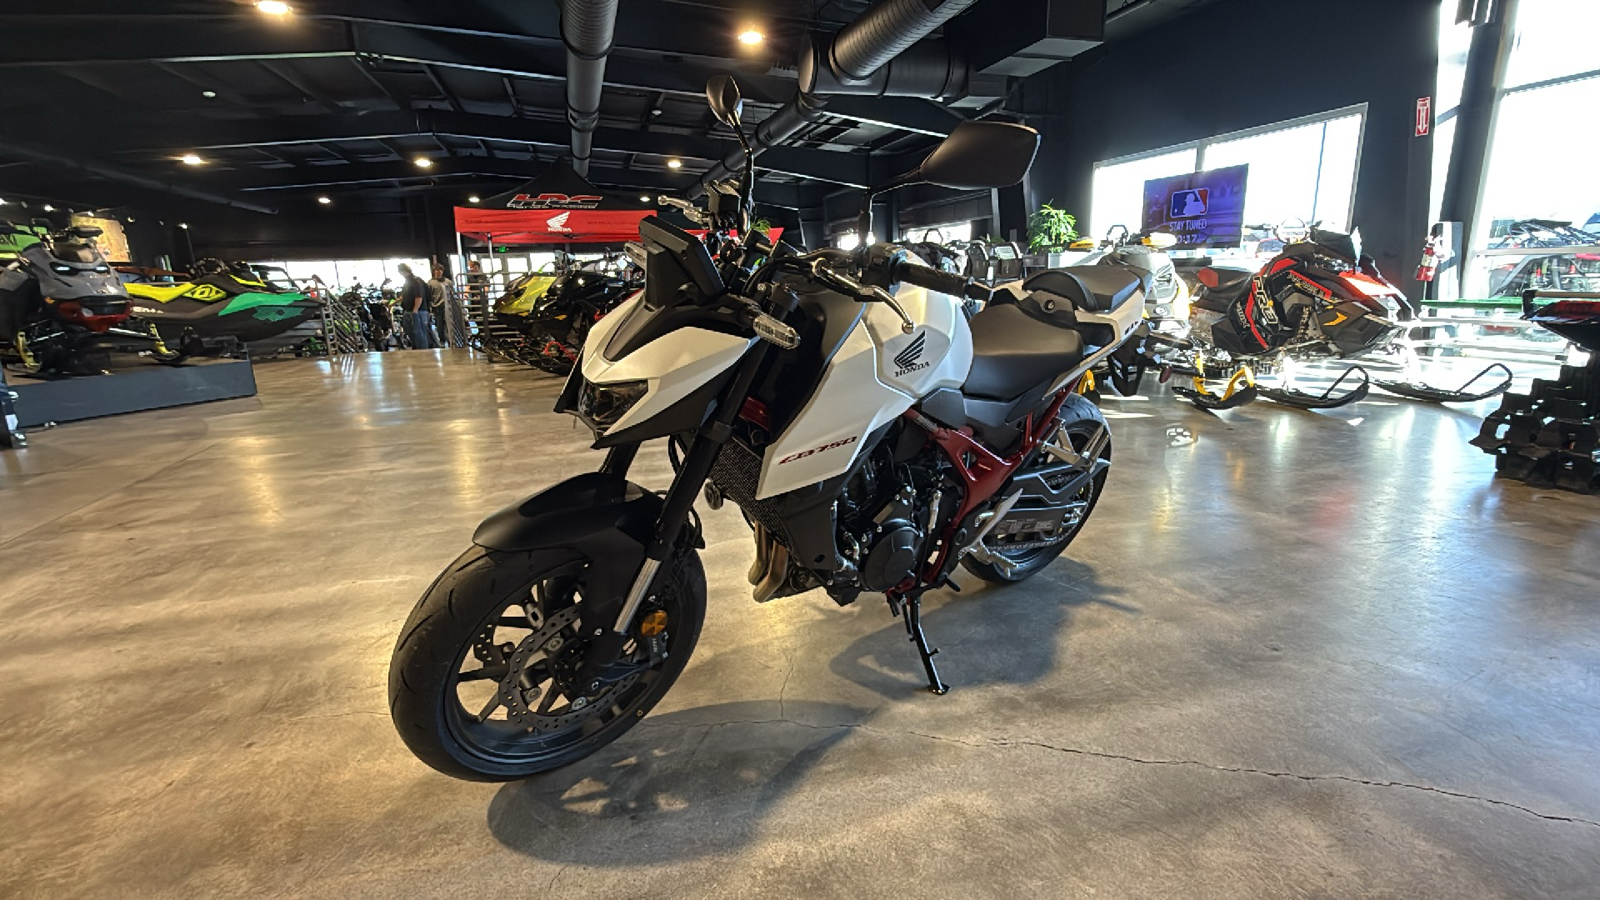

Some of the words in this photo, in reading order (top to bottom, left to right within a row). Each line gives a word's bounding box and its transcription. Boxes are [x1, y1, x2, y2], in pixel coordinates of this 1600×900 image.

[507, 193, 603, 207] HRC
[1169, 220, 1185, 232] STAY
[1186, 218, 1208, 231] TUNED
[895, 361, 930, 378] HONDA
[778, 436, 857, 465] CB750
